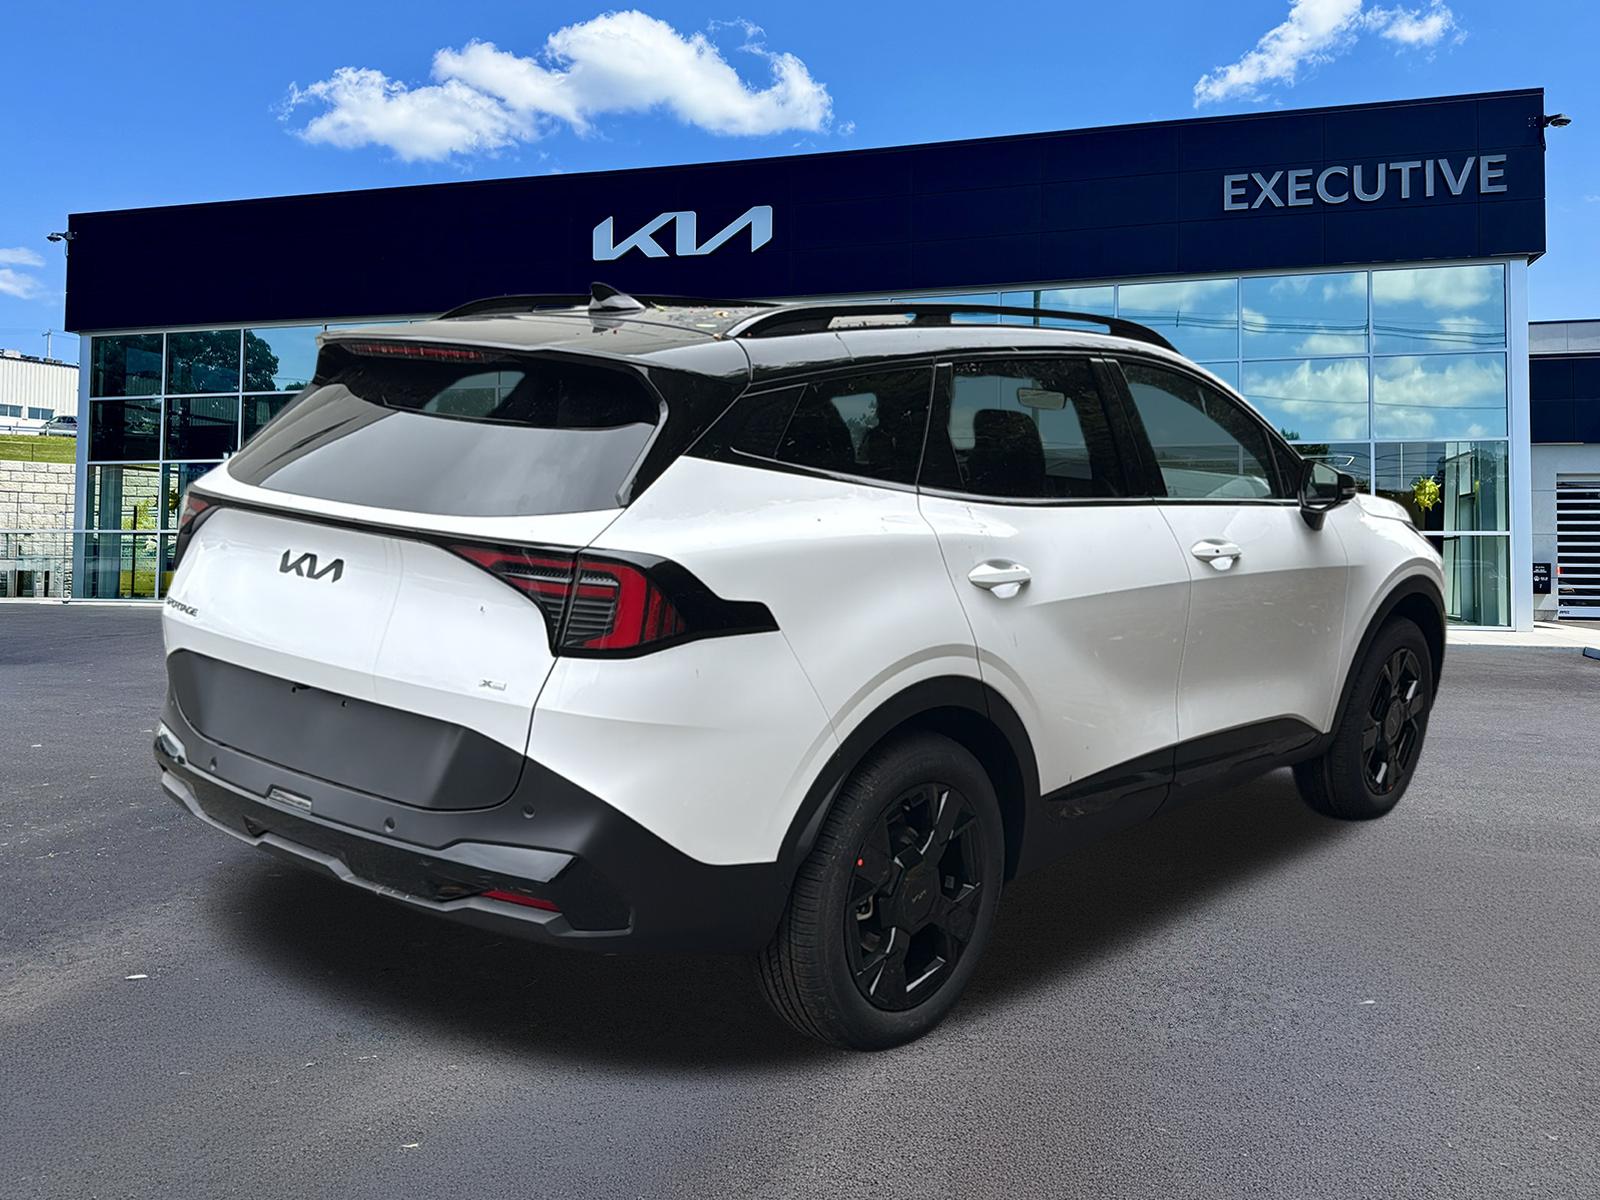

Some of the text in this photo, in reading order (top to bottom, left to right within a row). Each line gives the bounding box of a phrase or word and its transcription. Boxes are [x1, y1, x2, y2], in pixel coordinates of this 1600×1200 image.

[1223, 154, 1508, 211] EXECUTIVE
[593, 205, 773, 260] KIA
[279, 549, 344, 583] KIA
